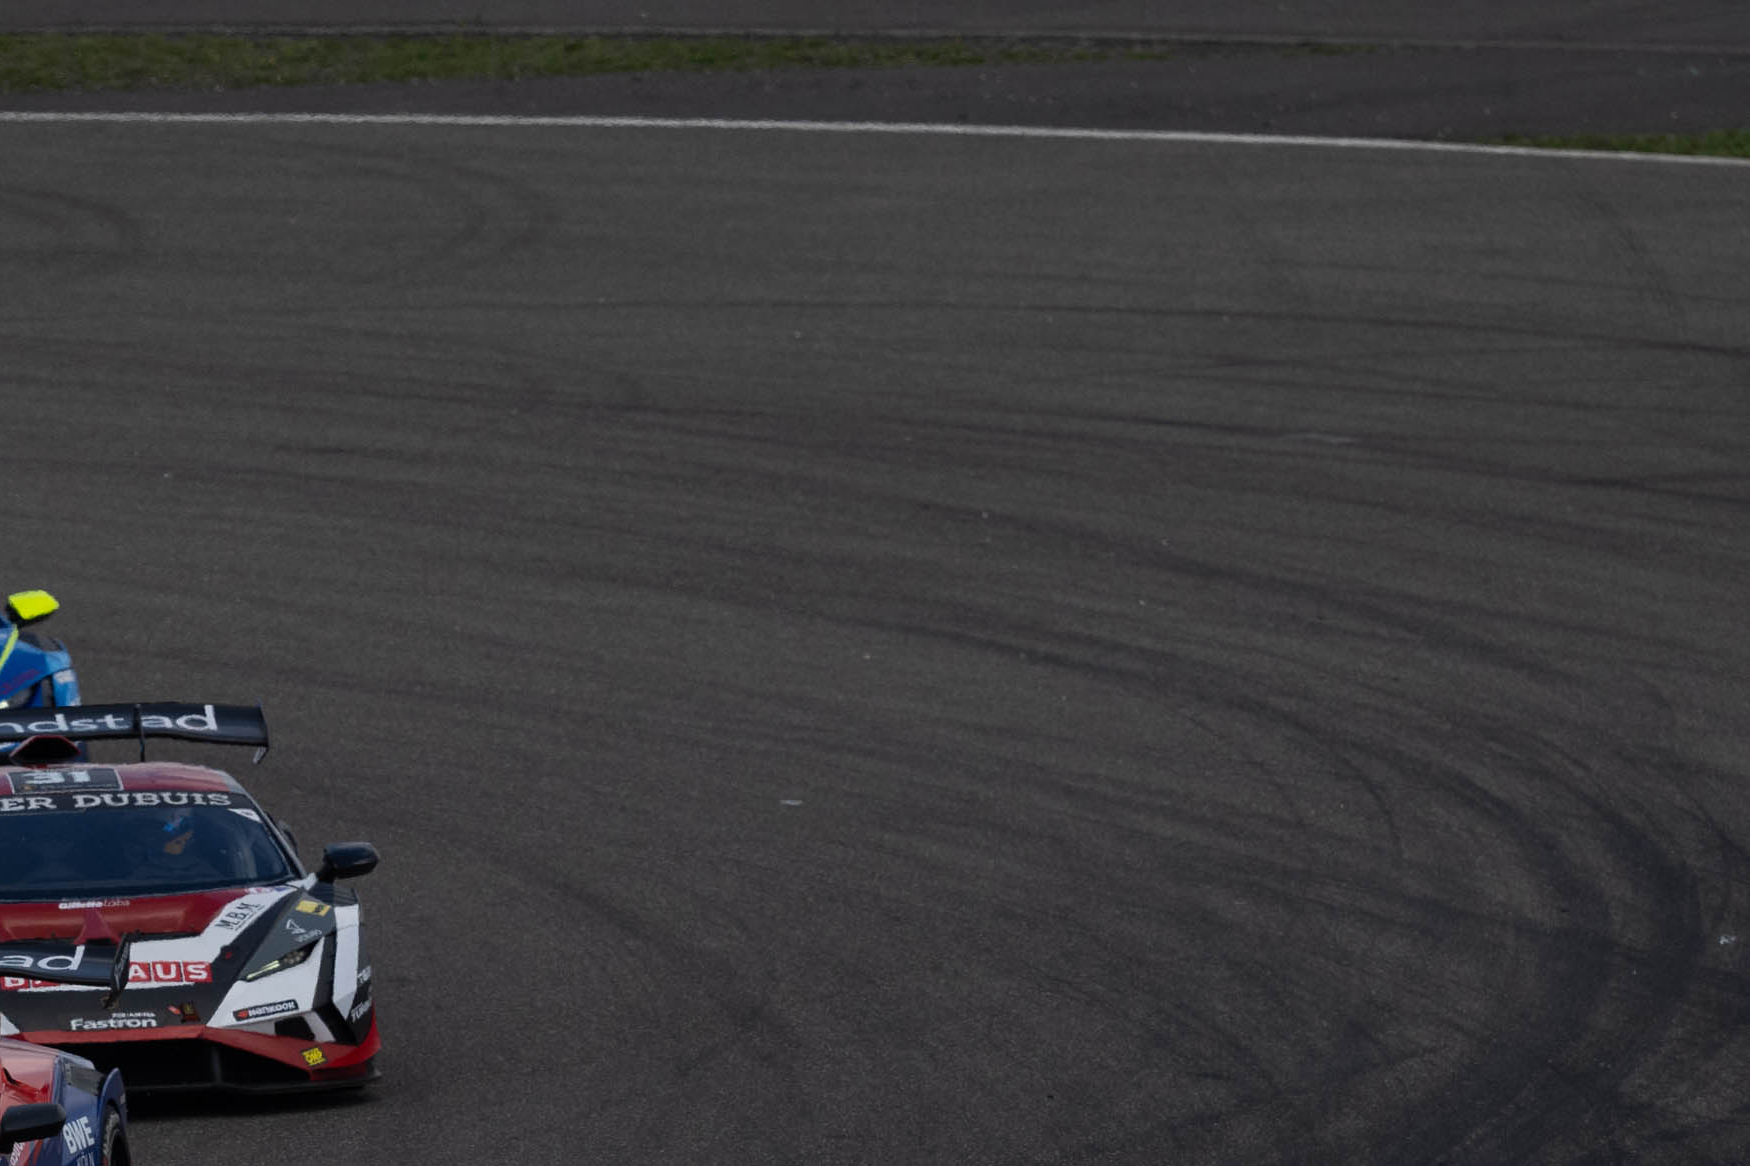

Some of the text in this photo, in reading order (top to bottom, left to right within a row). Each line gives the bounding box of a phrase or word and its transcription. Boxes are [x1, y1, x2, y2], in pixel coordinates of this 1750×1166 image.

[73, 792, 233, 809] DUBUIS
[70, 1018, 158, 1031] Fastron
[62, 1116, 96, 1155] BWE
